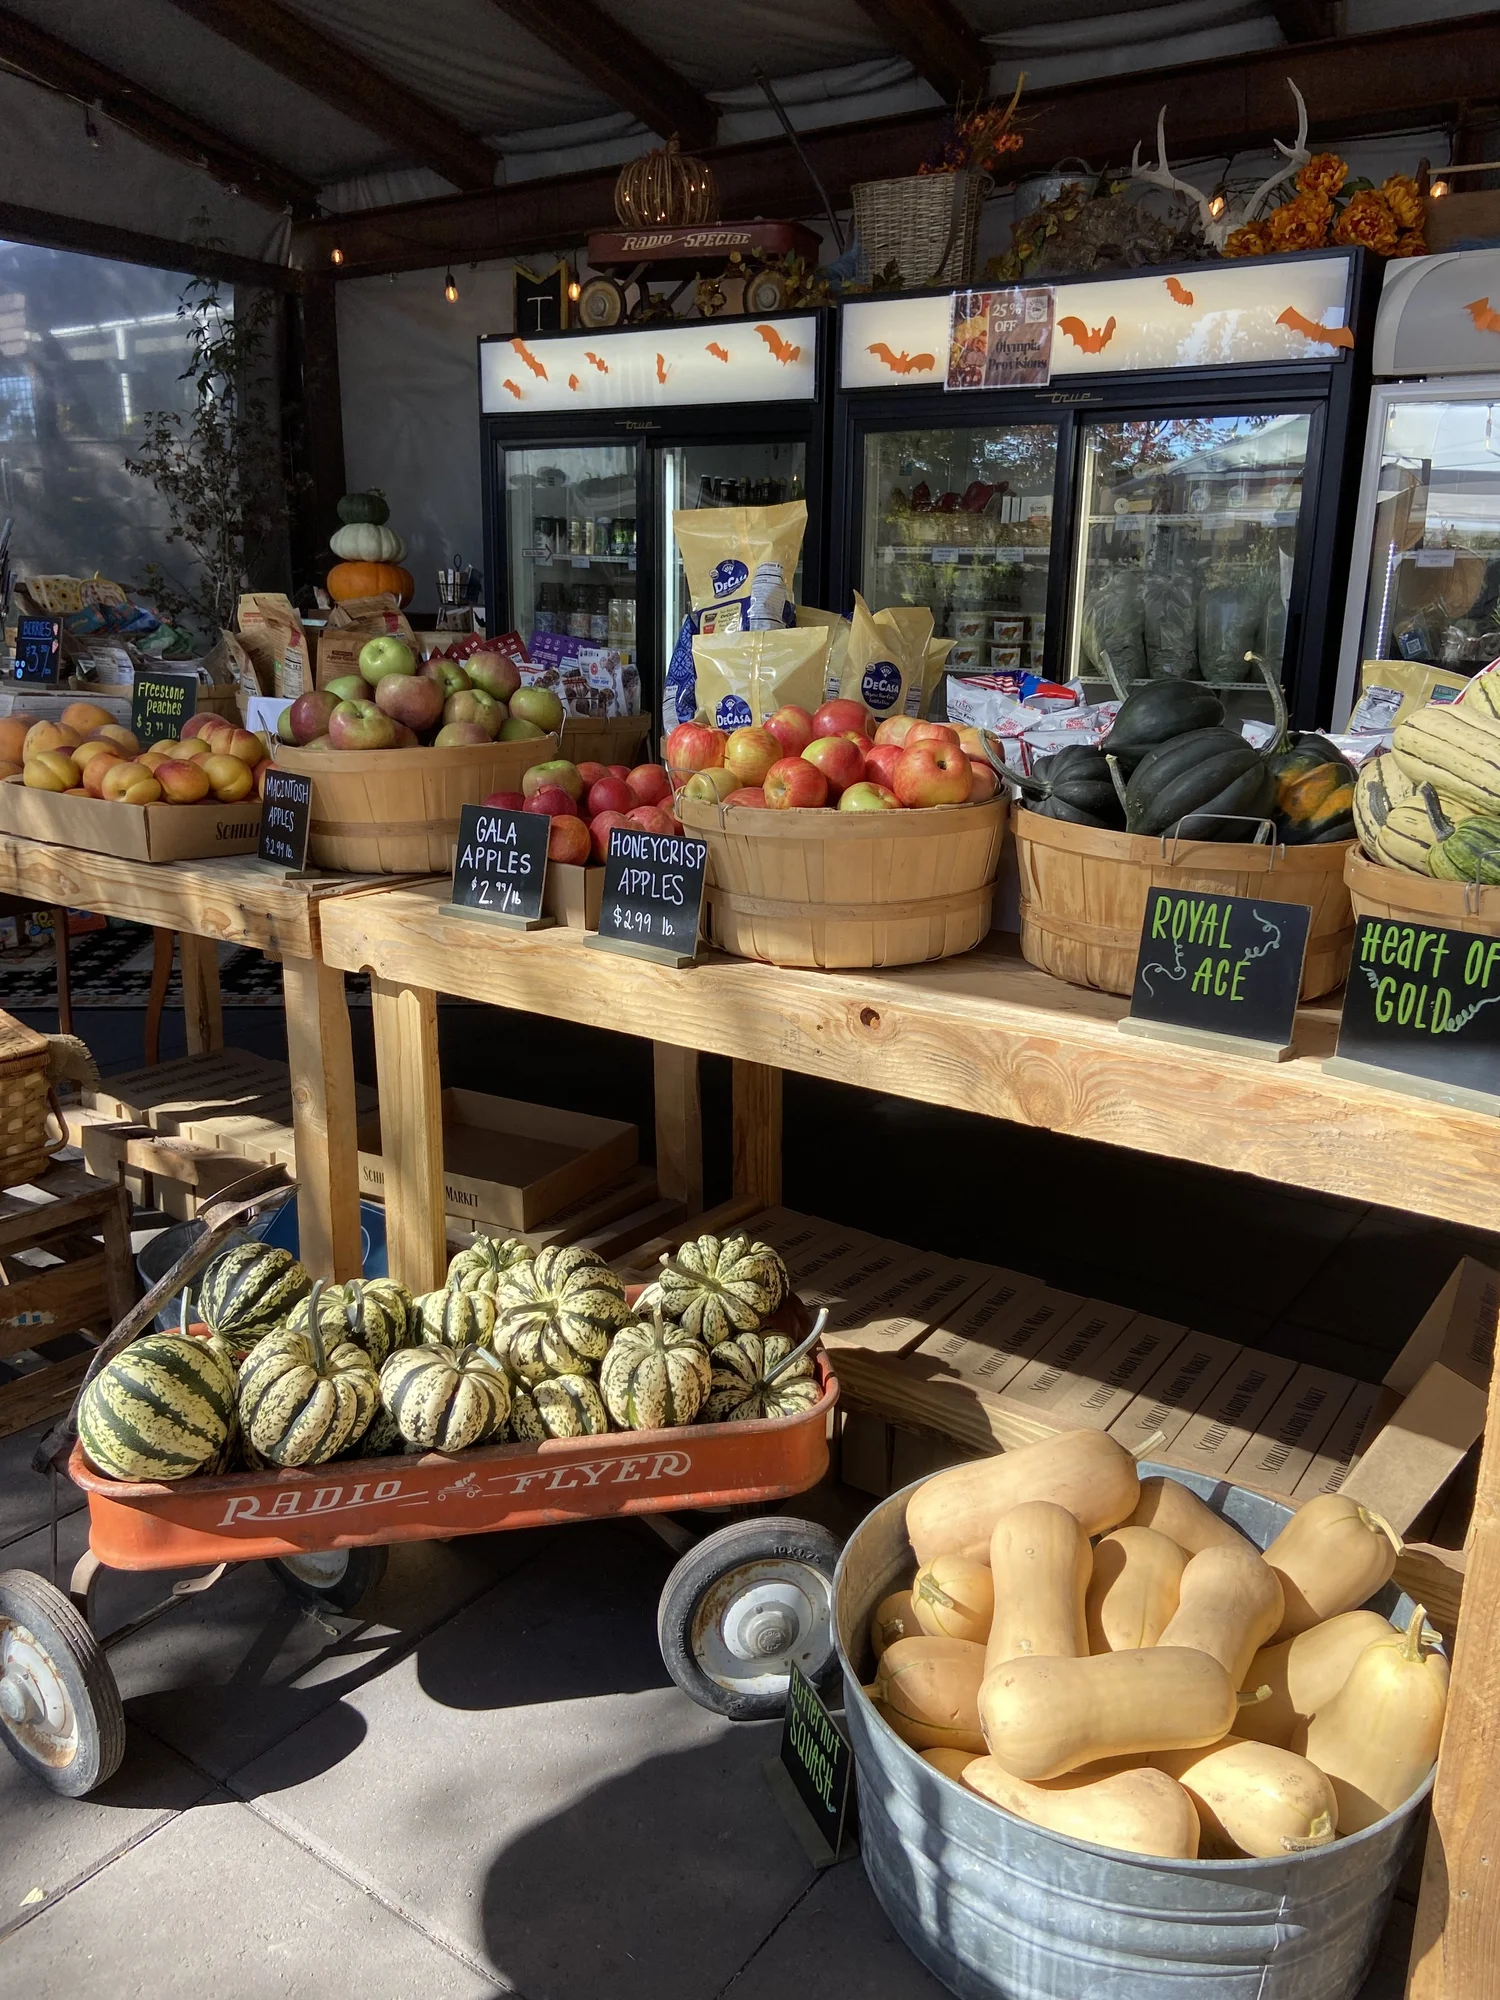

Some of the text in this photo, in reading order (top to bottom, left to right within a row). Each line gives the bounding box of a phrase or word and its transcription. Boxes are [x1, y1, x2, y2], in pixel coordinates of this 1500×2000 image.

[621, 231, 751, 251] RADIO SPECIAL
[994, 320, 1018, 333] OFF
[23, 620, 52, 637] BERRIES
[138, 682, 185, 700] Freestone
[266, 776, 309, 805] MACINTOSH
[267, 806, 295, 832] APPLES
[476, 815, 517, 846] GALA
[459, 844, 531, 875] APPLES
[610, 831, 706, 871] HONEYCRISP
[617, 867, 685, 906] APPLES
[613, 904, 676, 937] $2.99 lb.
[1151, 895, 1233, 950] ROYAL
[1360, 922, 1500, 988] Heart OF
[1191, 957, 1251, 1001] ACE
[1375, 975, 1452, 1034] GOLD
[445, 1185, 479, 1208] MARKET
[217, 1450, 692, 1527] RADIO FLYER
